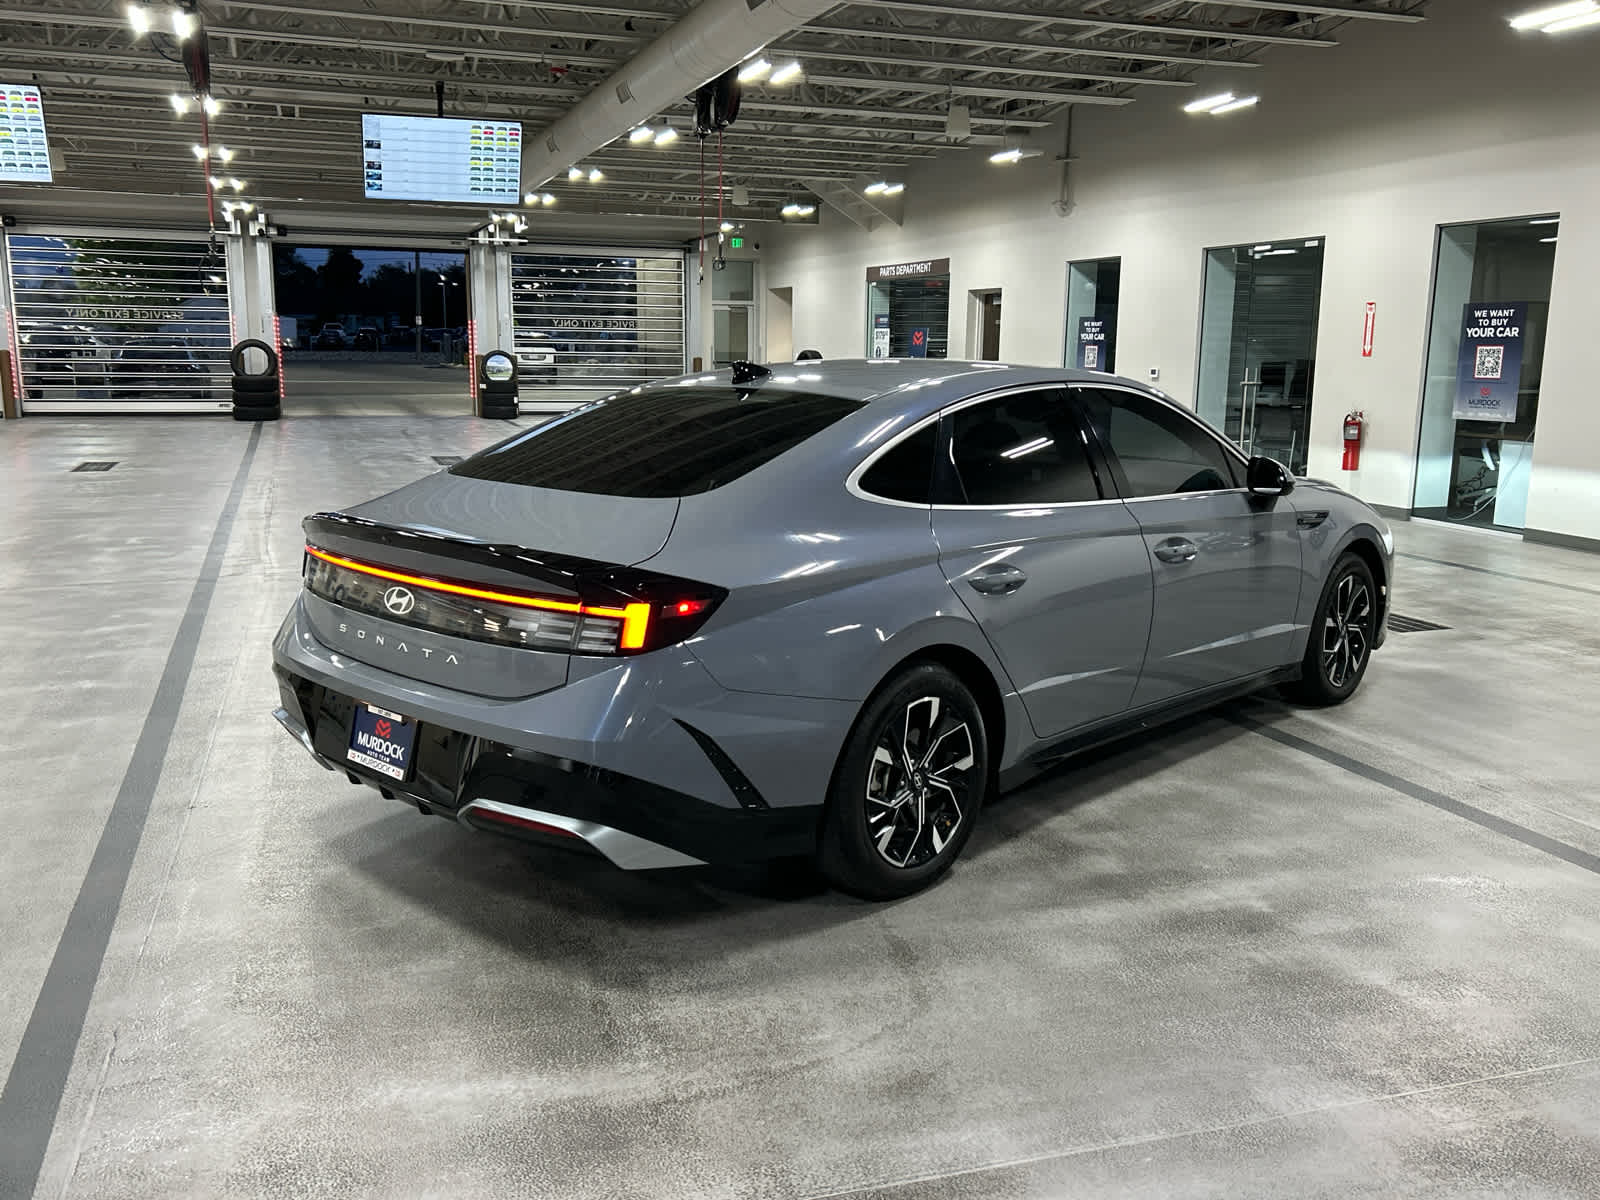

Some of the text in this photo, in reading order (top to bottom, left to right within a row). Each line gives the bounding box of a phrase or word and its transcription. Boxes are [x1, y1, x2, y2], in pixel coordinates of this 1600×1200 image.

[880, 263, 932, 276] PARTS DEPARTMENT
[1474, 309, 1515, 318] WE WANT
[1491, 318, 1509, 326] BUY
[1466, 327, 1520, 338] YOUR CAR
[339, 623, 459, 665] SONATA
[357, 730, 405, 761] MURDOCK
[367, 749, 378, 758] AUTO
